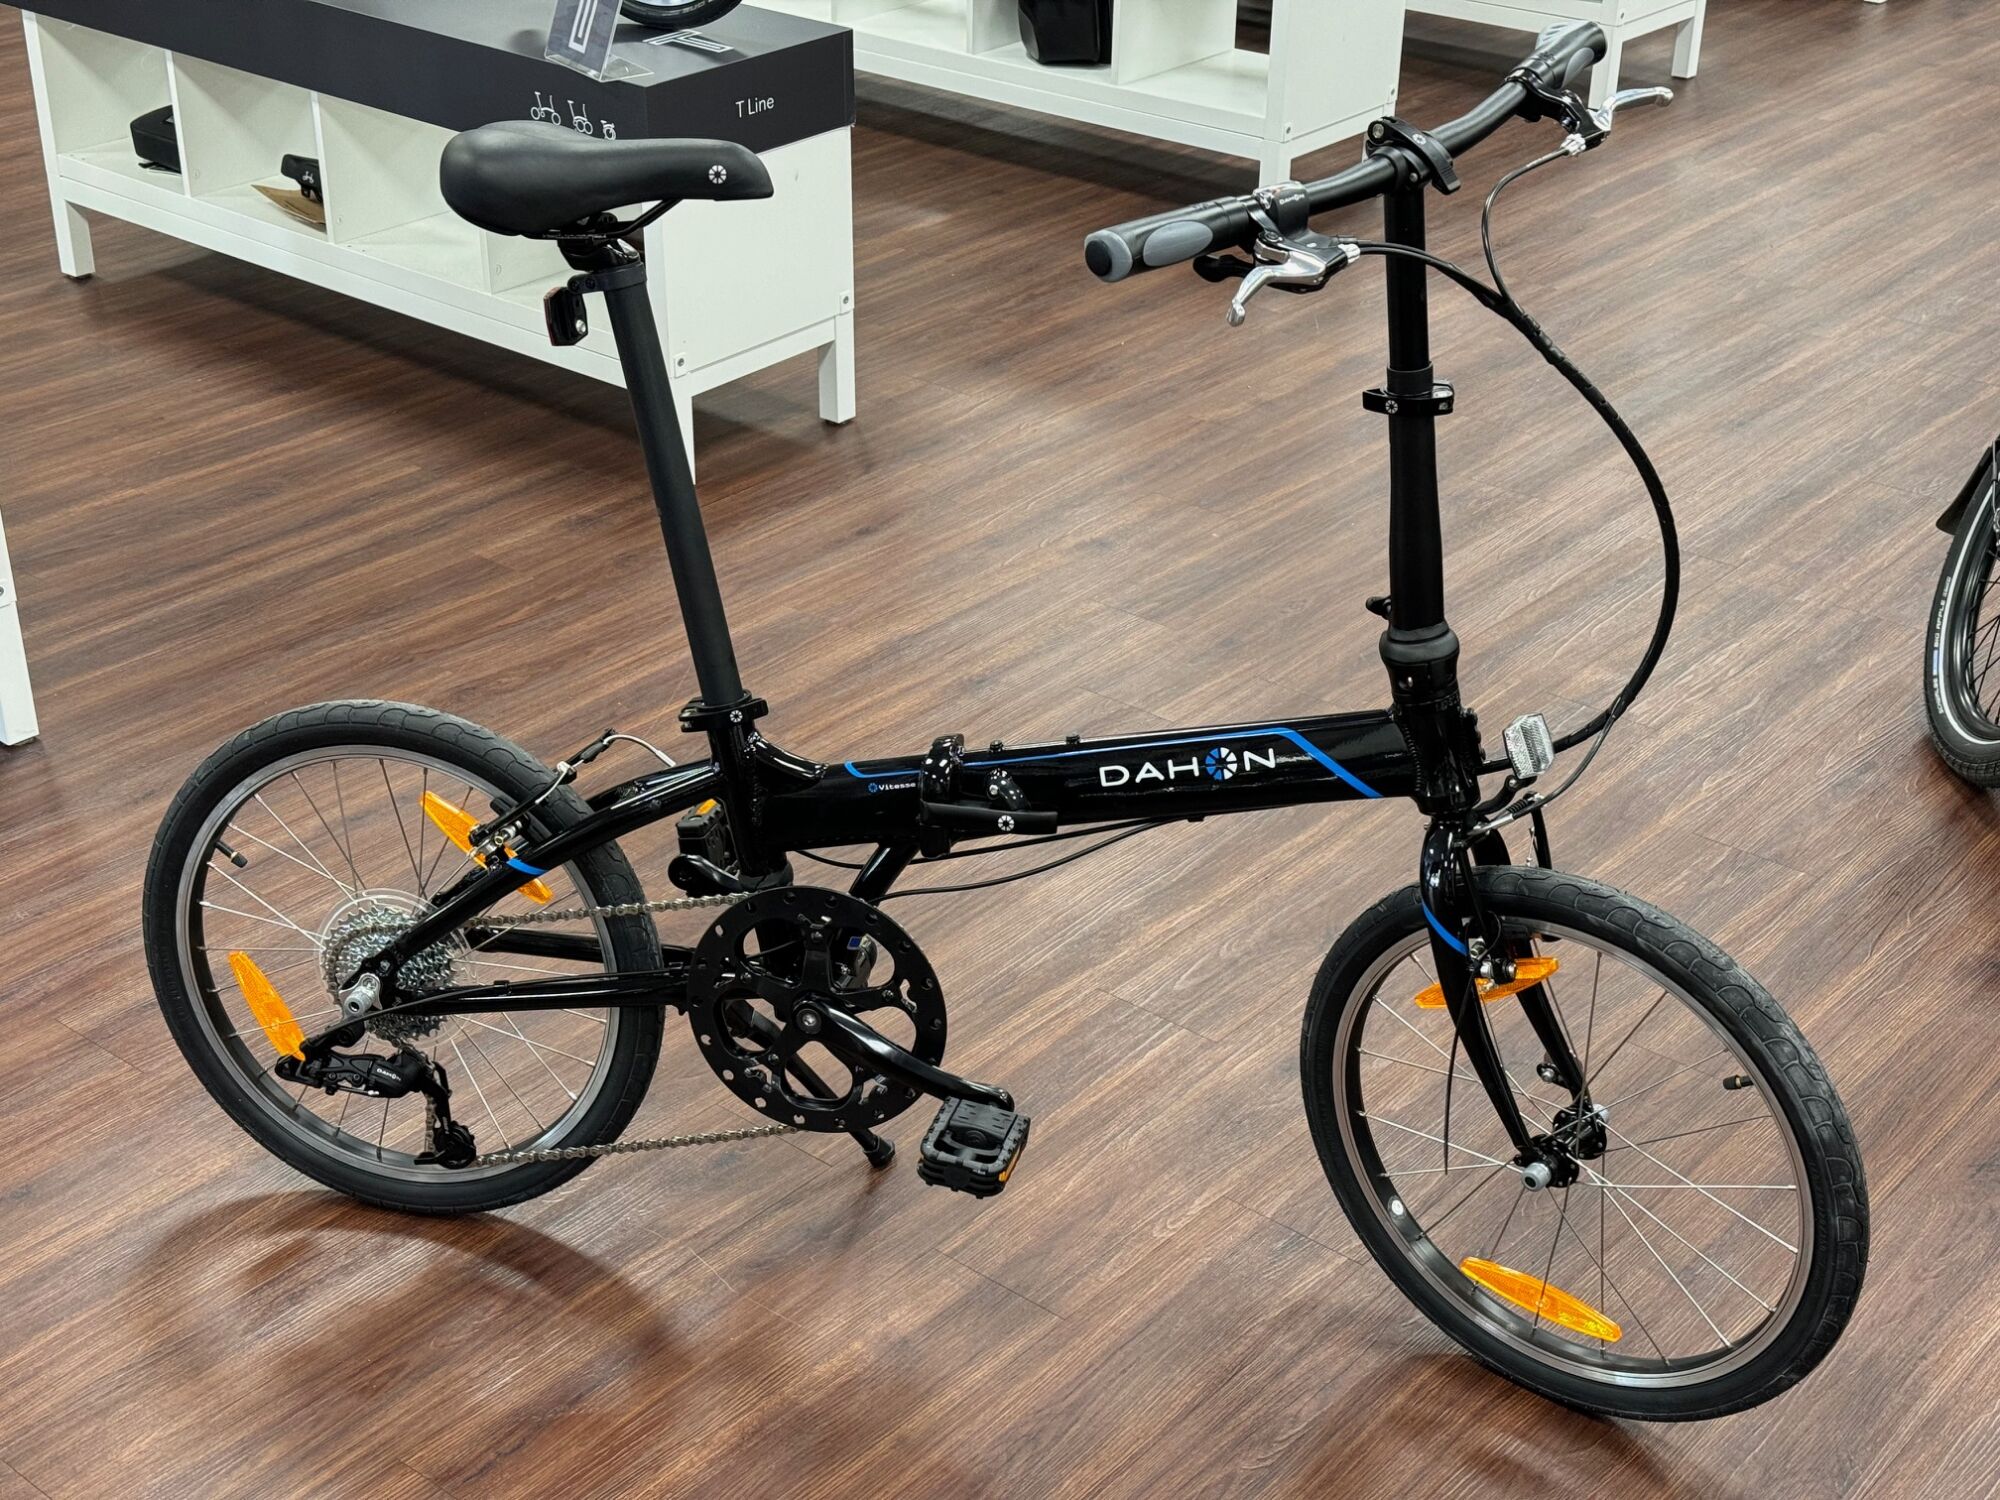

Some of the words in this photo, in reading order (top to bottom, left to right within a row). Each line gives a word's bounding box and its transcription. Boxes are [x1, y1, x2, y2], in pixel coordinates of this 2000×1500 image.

[735, 100, 745, 118] T
[747, 97, 775, 115] Line
[1099, 747, 1276, 788] DAHON
